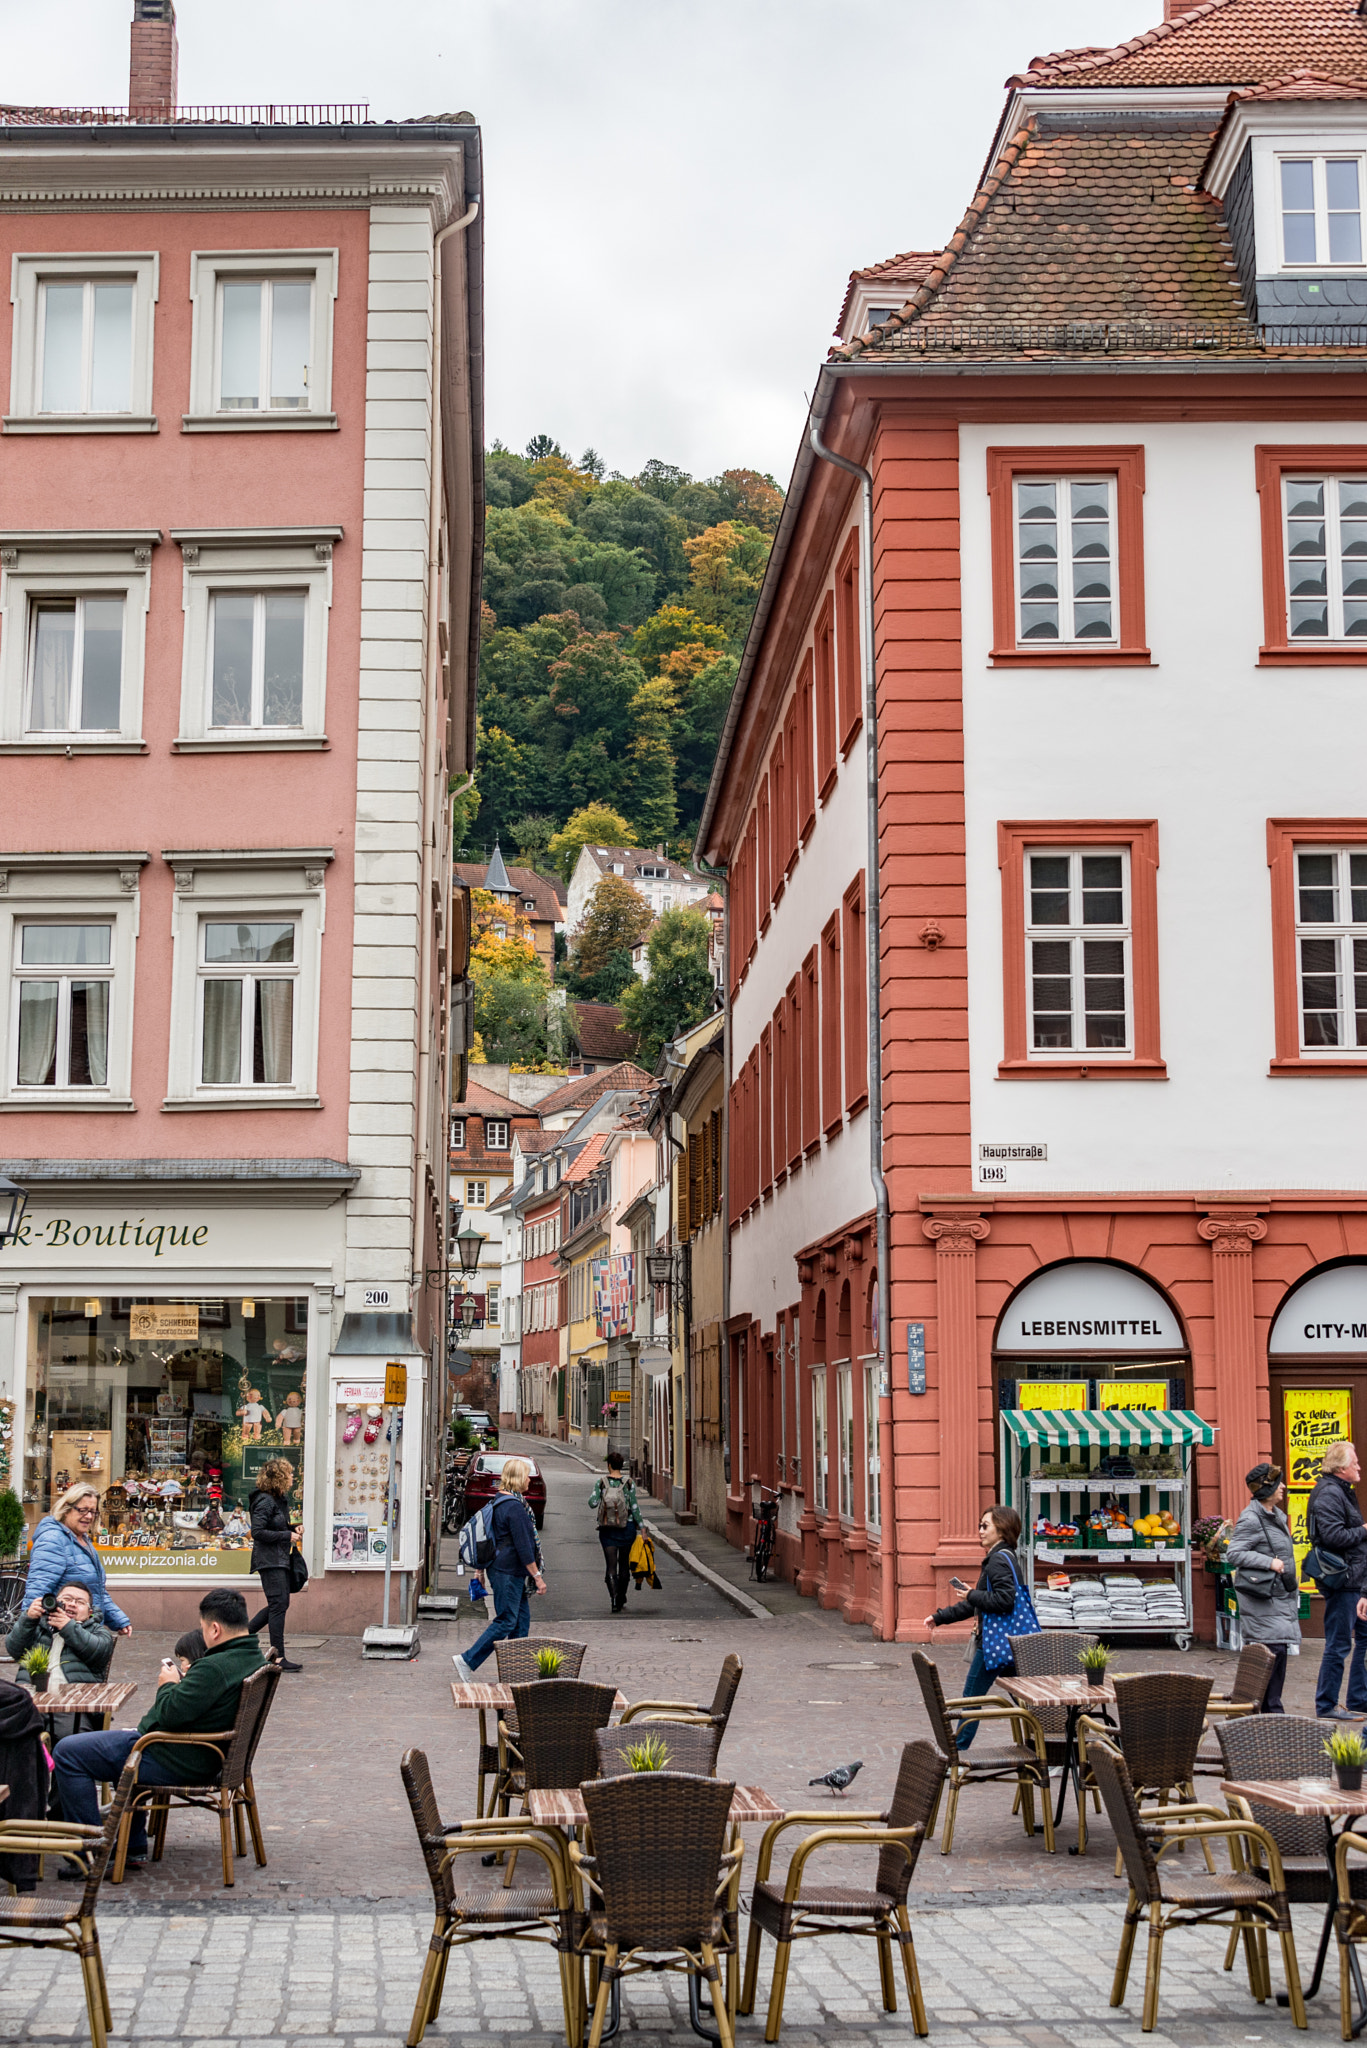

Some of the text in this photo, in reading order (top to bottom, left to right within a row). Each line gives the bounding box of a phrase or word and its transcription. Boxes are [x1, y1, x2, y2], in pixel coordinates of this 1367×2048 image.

[983, 1146, 1043, 1158] Hauptstraße
[982, 1167, 1004, 1180] 198
[366, 1291, 389, 1304] 200
[160, 1319, 197, 1327] SCHNEIDER
[1021, 1320, 1162, 1336] LEBENSMITTEL
[1304, 1323, 1367, 1340] CITY-M
[102, 1553, 218, 1569] www.pizzonia.de
